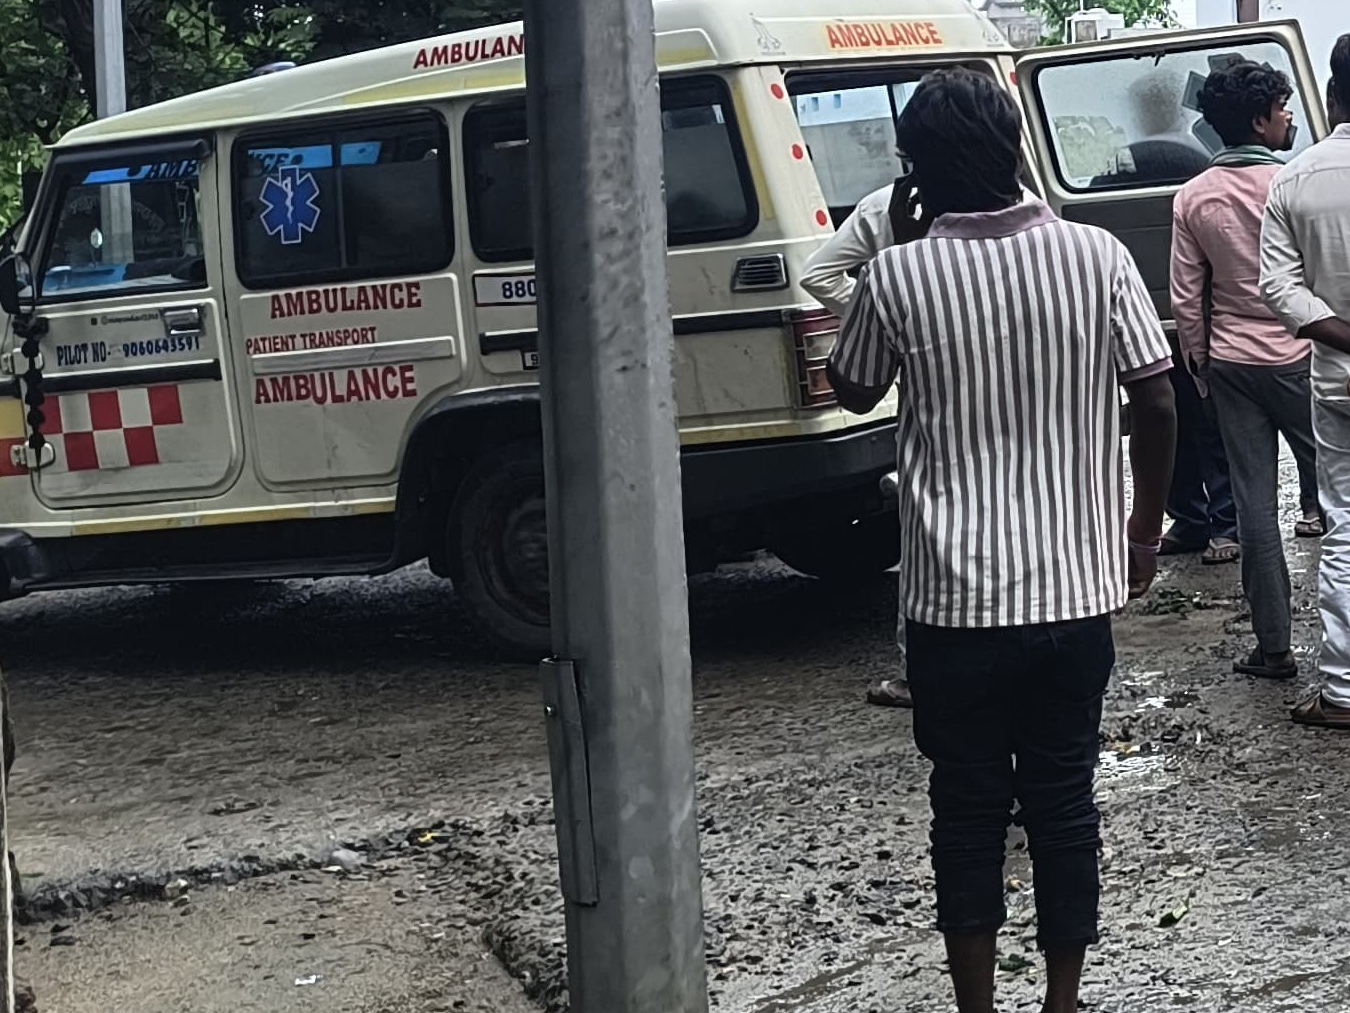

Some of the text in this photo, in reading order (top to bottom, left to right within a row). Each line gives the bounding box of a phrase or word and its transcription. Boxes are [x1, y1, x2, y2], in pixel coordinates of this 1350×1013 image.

[826, 22, 943, 48] AMBULANCE
[413, 33, 524, 69] AMBULAN
[271, 282, 422, 319] AMBULANCE
[501, 278, 537, 299] 880
[56, 342, 89, 367] PILOT
[245, 326, 377, 355] PATIENT TRANSPORT
[254, 364, 418, 405] AMBULANCE
